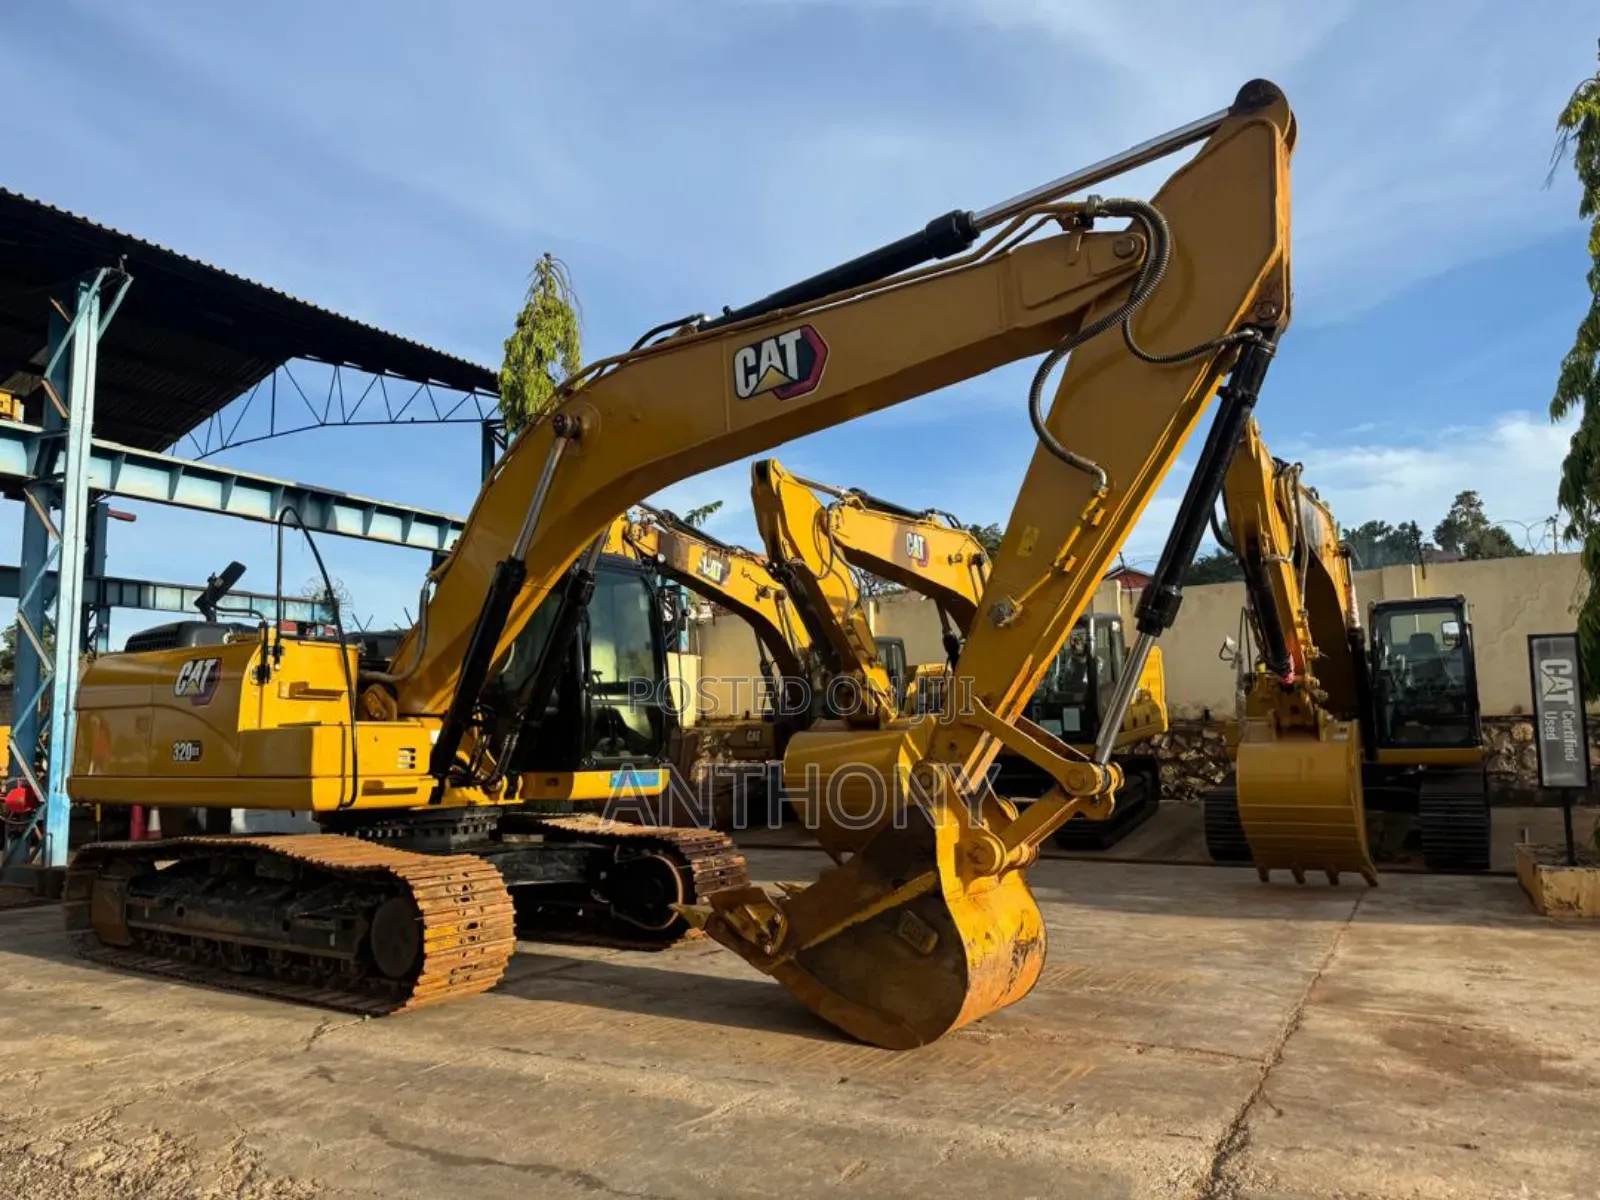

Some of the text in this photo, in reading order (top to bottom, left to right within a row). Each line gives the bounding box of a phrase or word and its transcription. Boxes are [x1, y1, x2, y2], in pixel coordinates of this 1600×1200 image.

[734, 328, 802, 398] CAT
[906, 532, 924, 560] CAT
[175, 659, 217, 696] CAT
[1540, 658, 1575, 705] CAT
[1544, 710, 1560, 741] Used
[1561, 710, 1579, 762] Certified
[173, 742, 192, 761] 320
